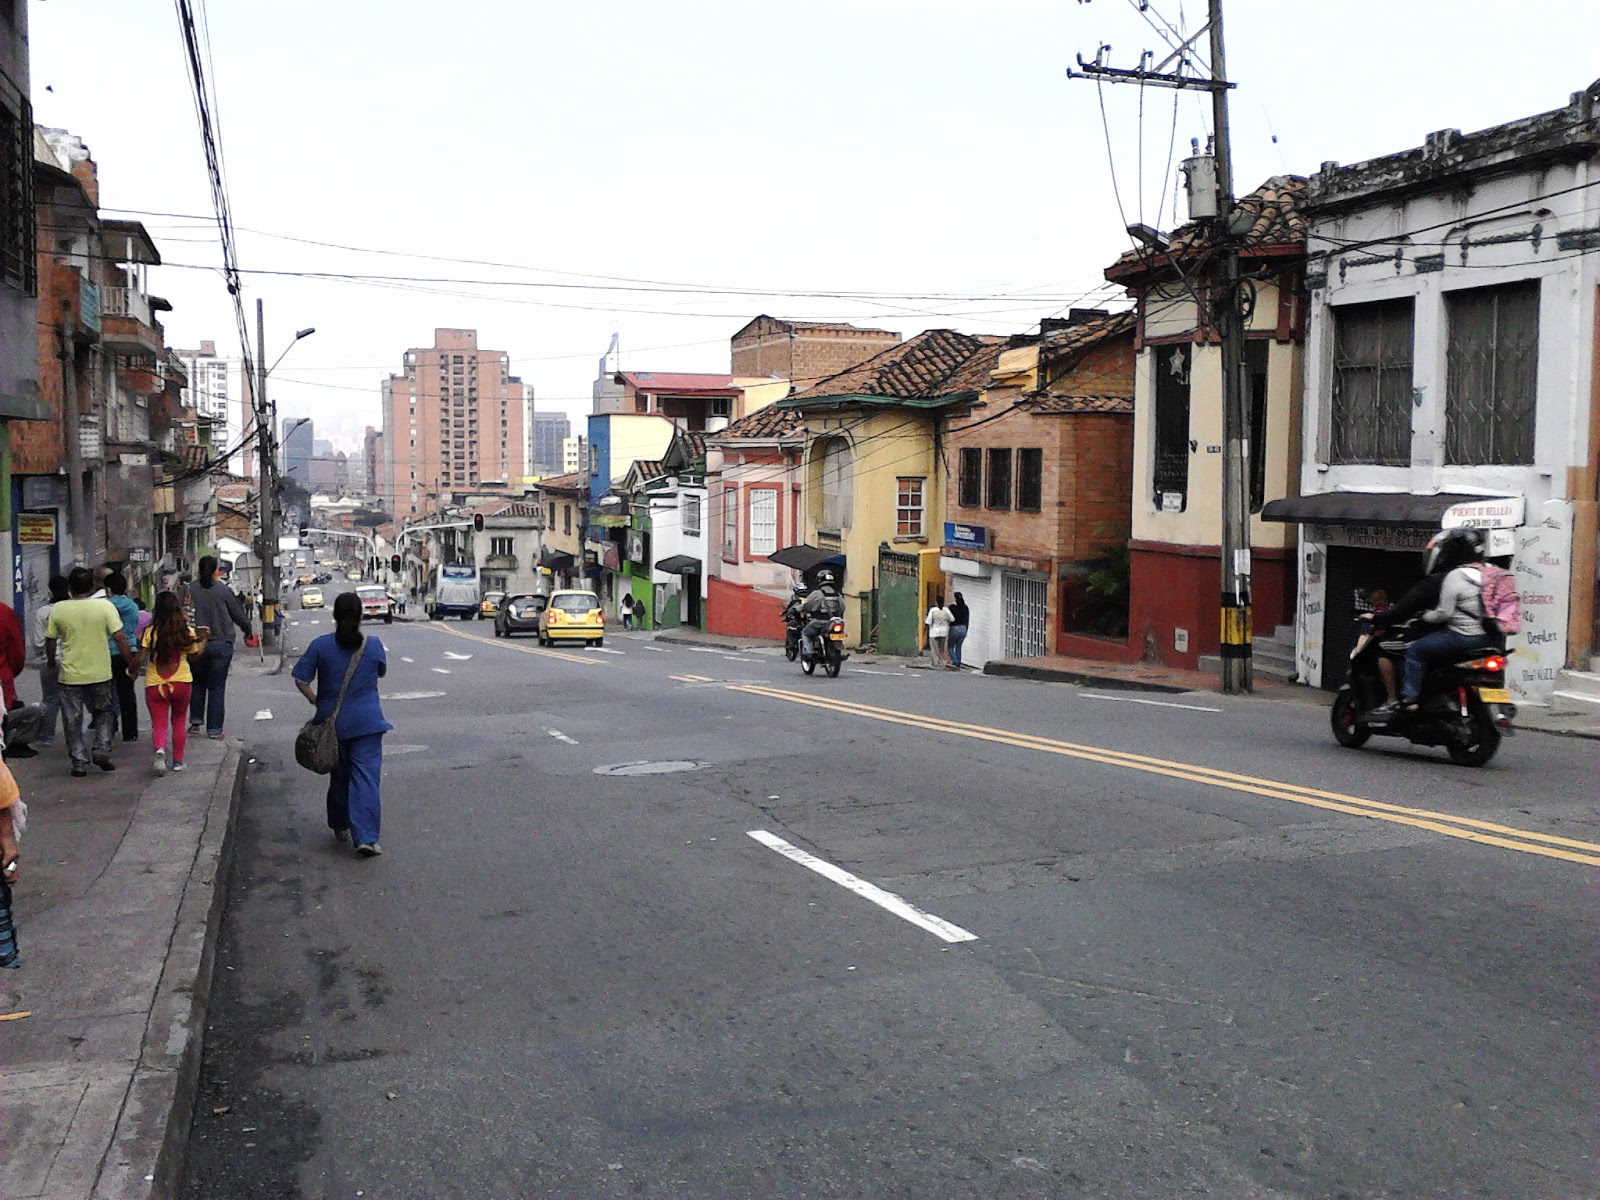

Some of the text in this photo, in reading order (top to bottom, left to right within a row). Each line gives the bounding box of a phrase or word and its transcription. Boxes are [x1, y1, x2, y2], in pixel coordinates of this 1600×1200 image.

[1395, 536, 1424, 548] BELLE
[129, 552, 149, 561] HIELO
[15, 554, 23, 593] FAX
